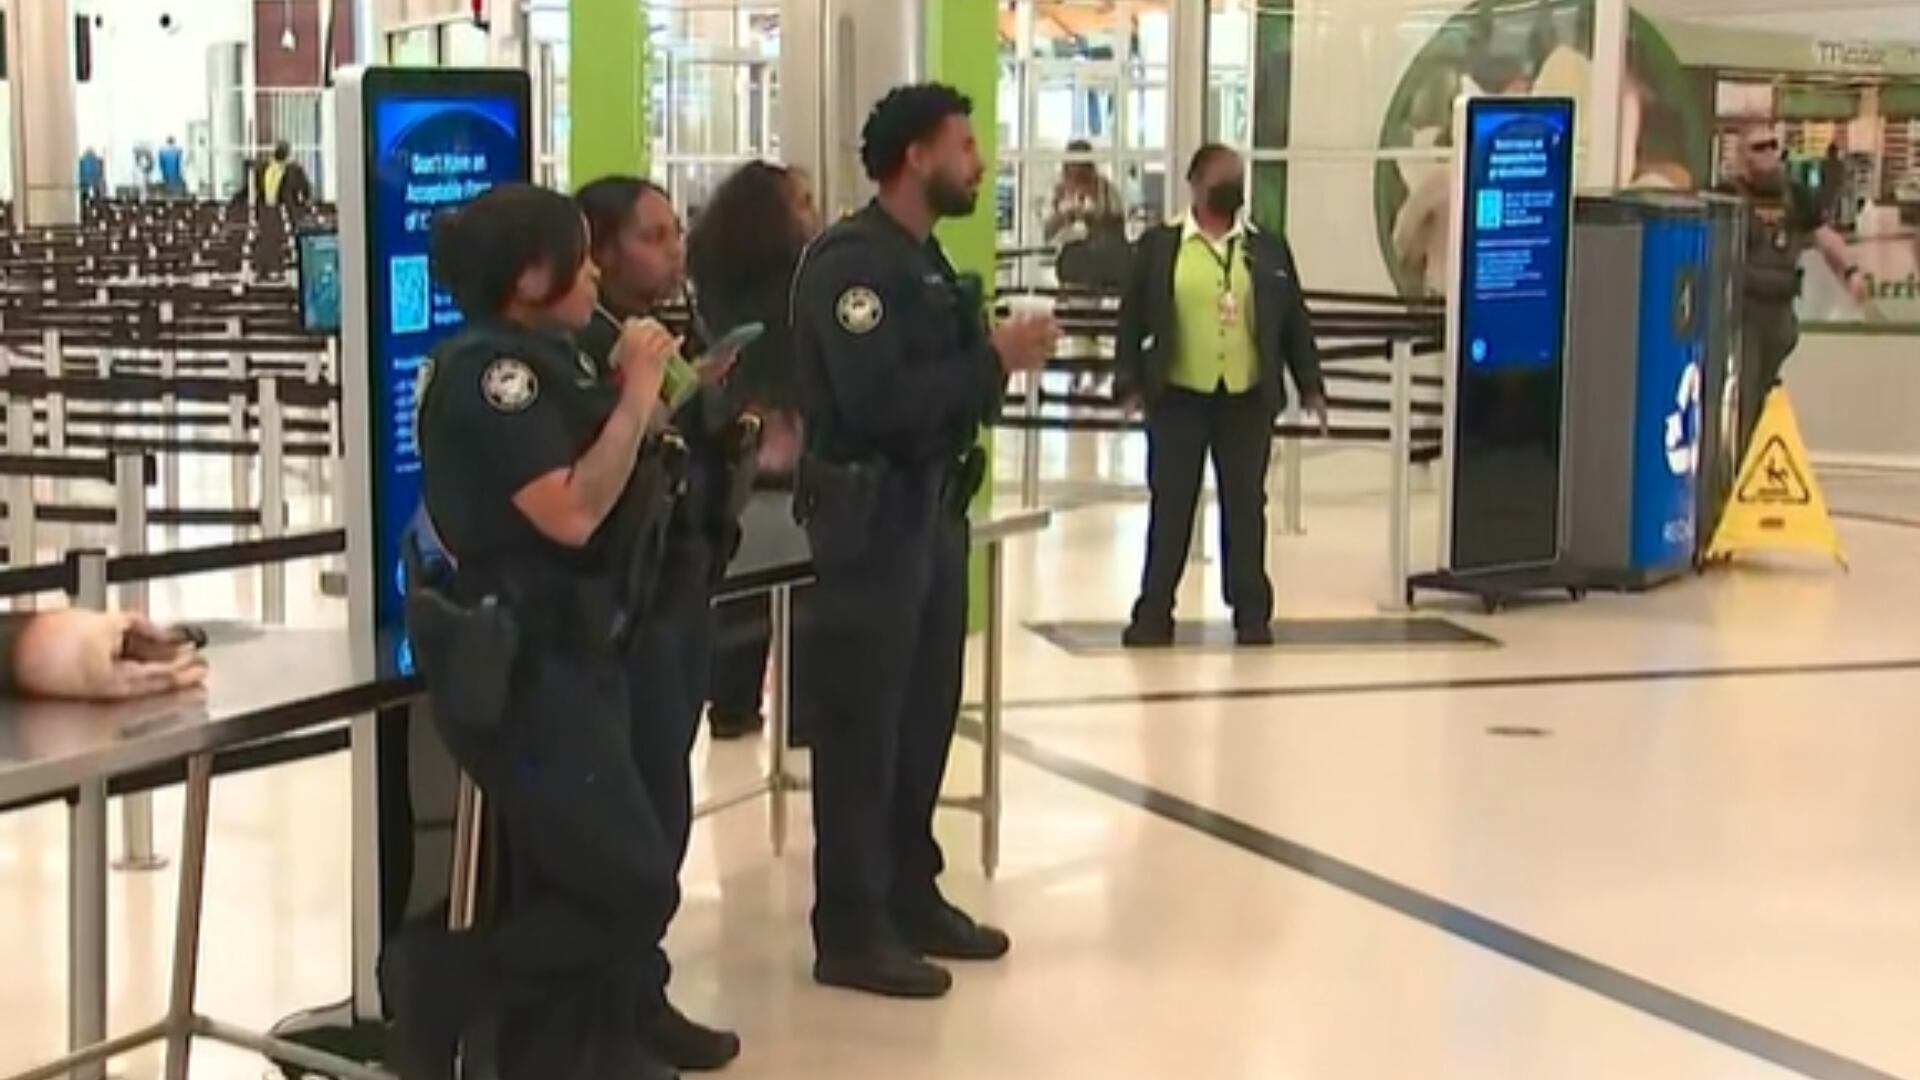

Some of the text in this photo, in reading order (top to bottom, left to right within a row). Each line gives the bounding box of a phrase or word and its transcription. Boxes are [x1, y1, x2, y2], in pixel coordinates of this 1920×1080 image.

[411, 153, 441, 174] Don't
[444, 153, 470, 173] Have
[405, 181, 461, 204] Acceptable
